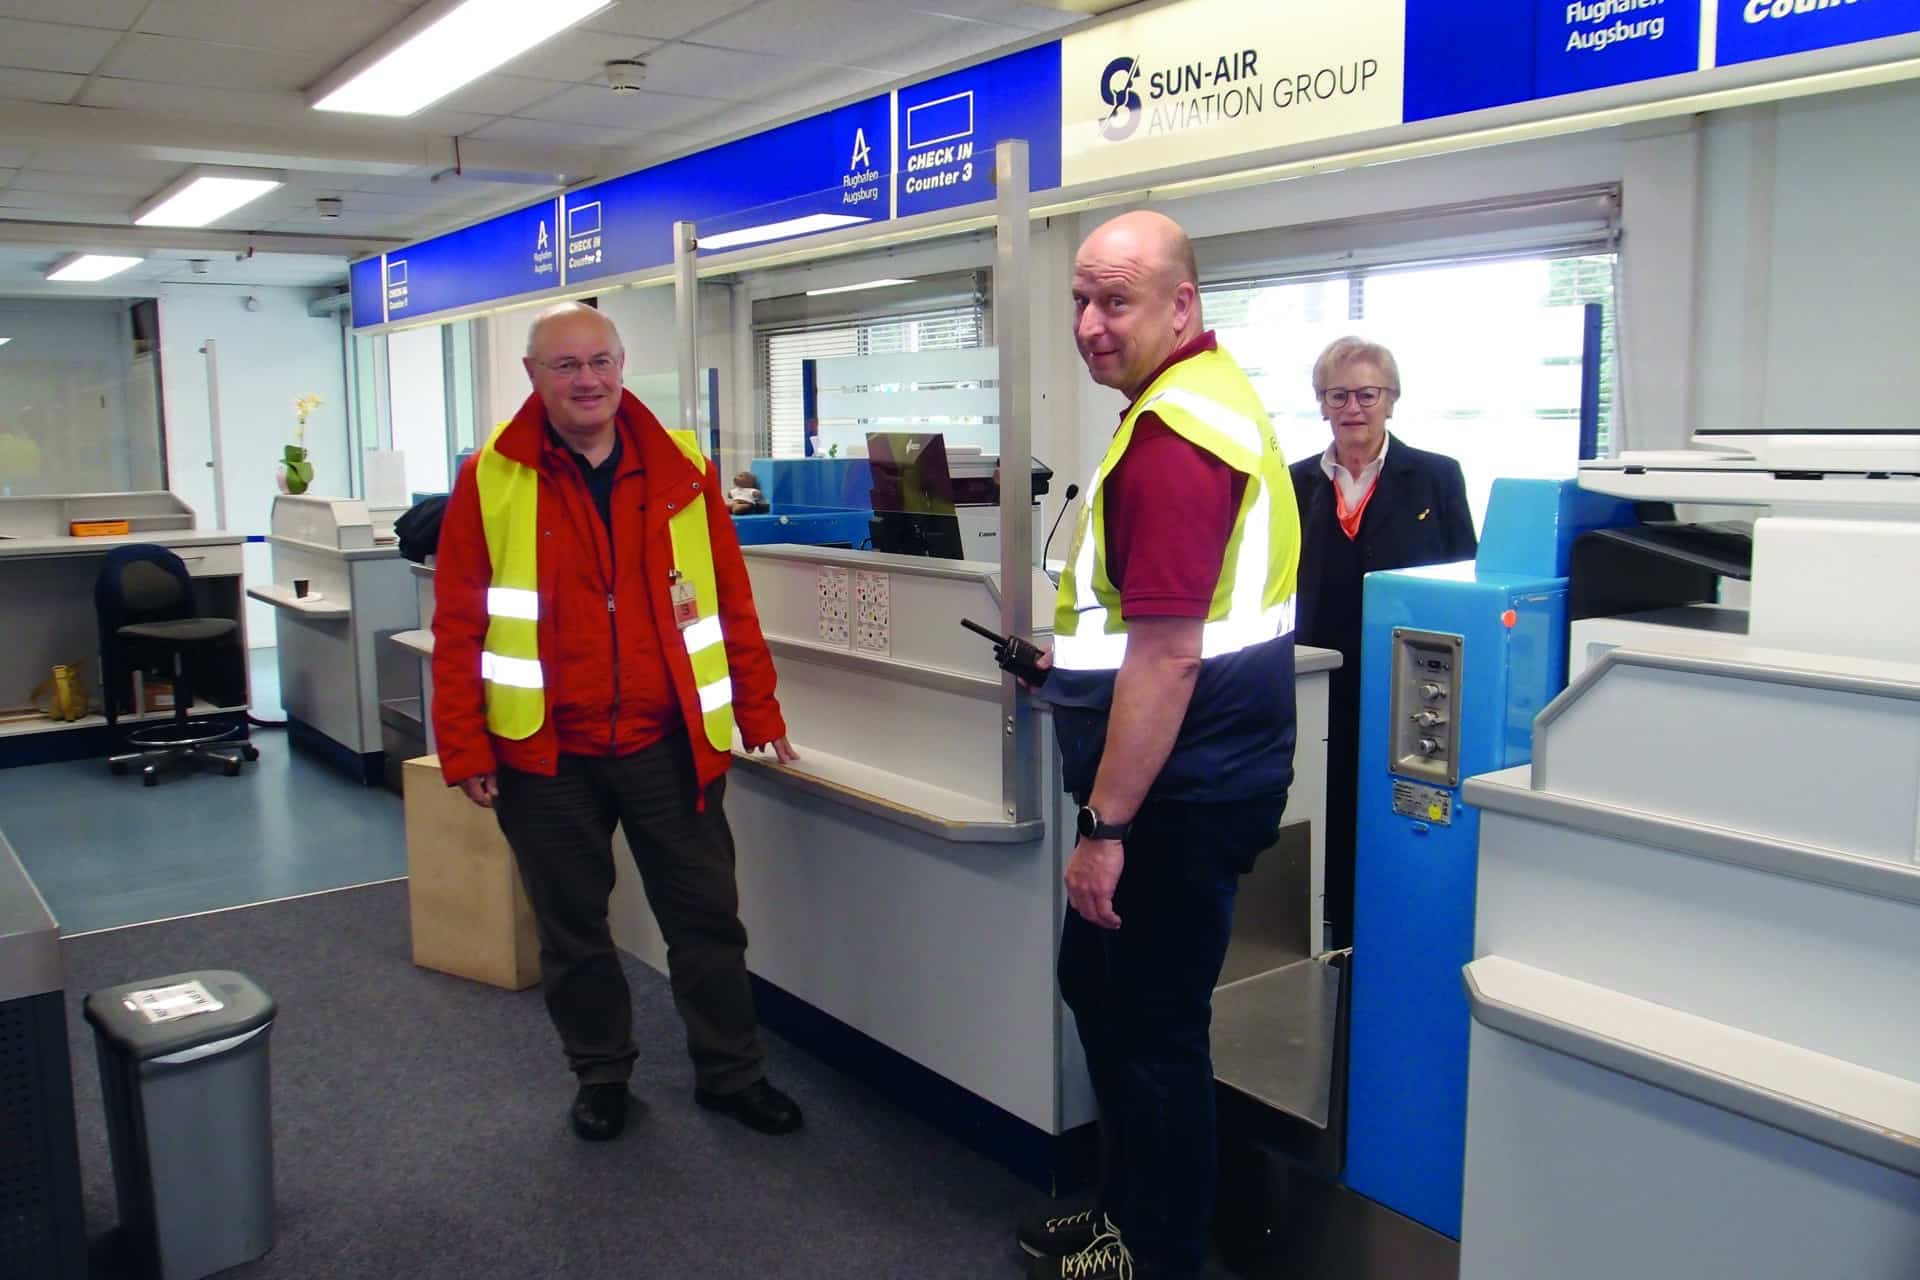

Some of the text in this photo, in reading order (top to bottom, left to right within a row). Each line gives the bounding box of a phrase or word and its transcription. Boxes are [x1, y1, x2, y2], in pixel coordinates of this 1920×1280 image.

[1566, 0, 1664, 24] Flughae
[1565, 17, 1664, 52] Augsburg
[1150, 49, 1257, 99] SUN-AIR
[1149, 59, 1378, 136] AVIATION GROUP
[908, 142, 973, 172] CHECK IN
[843, 169, 879, 188] Flughafen
[906, 163, 973, 193] Counter 3
[843, 187, 878, 205] Augsburg
